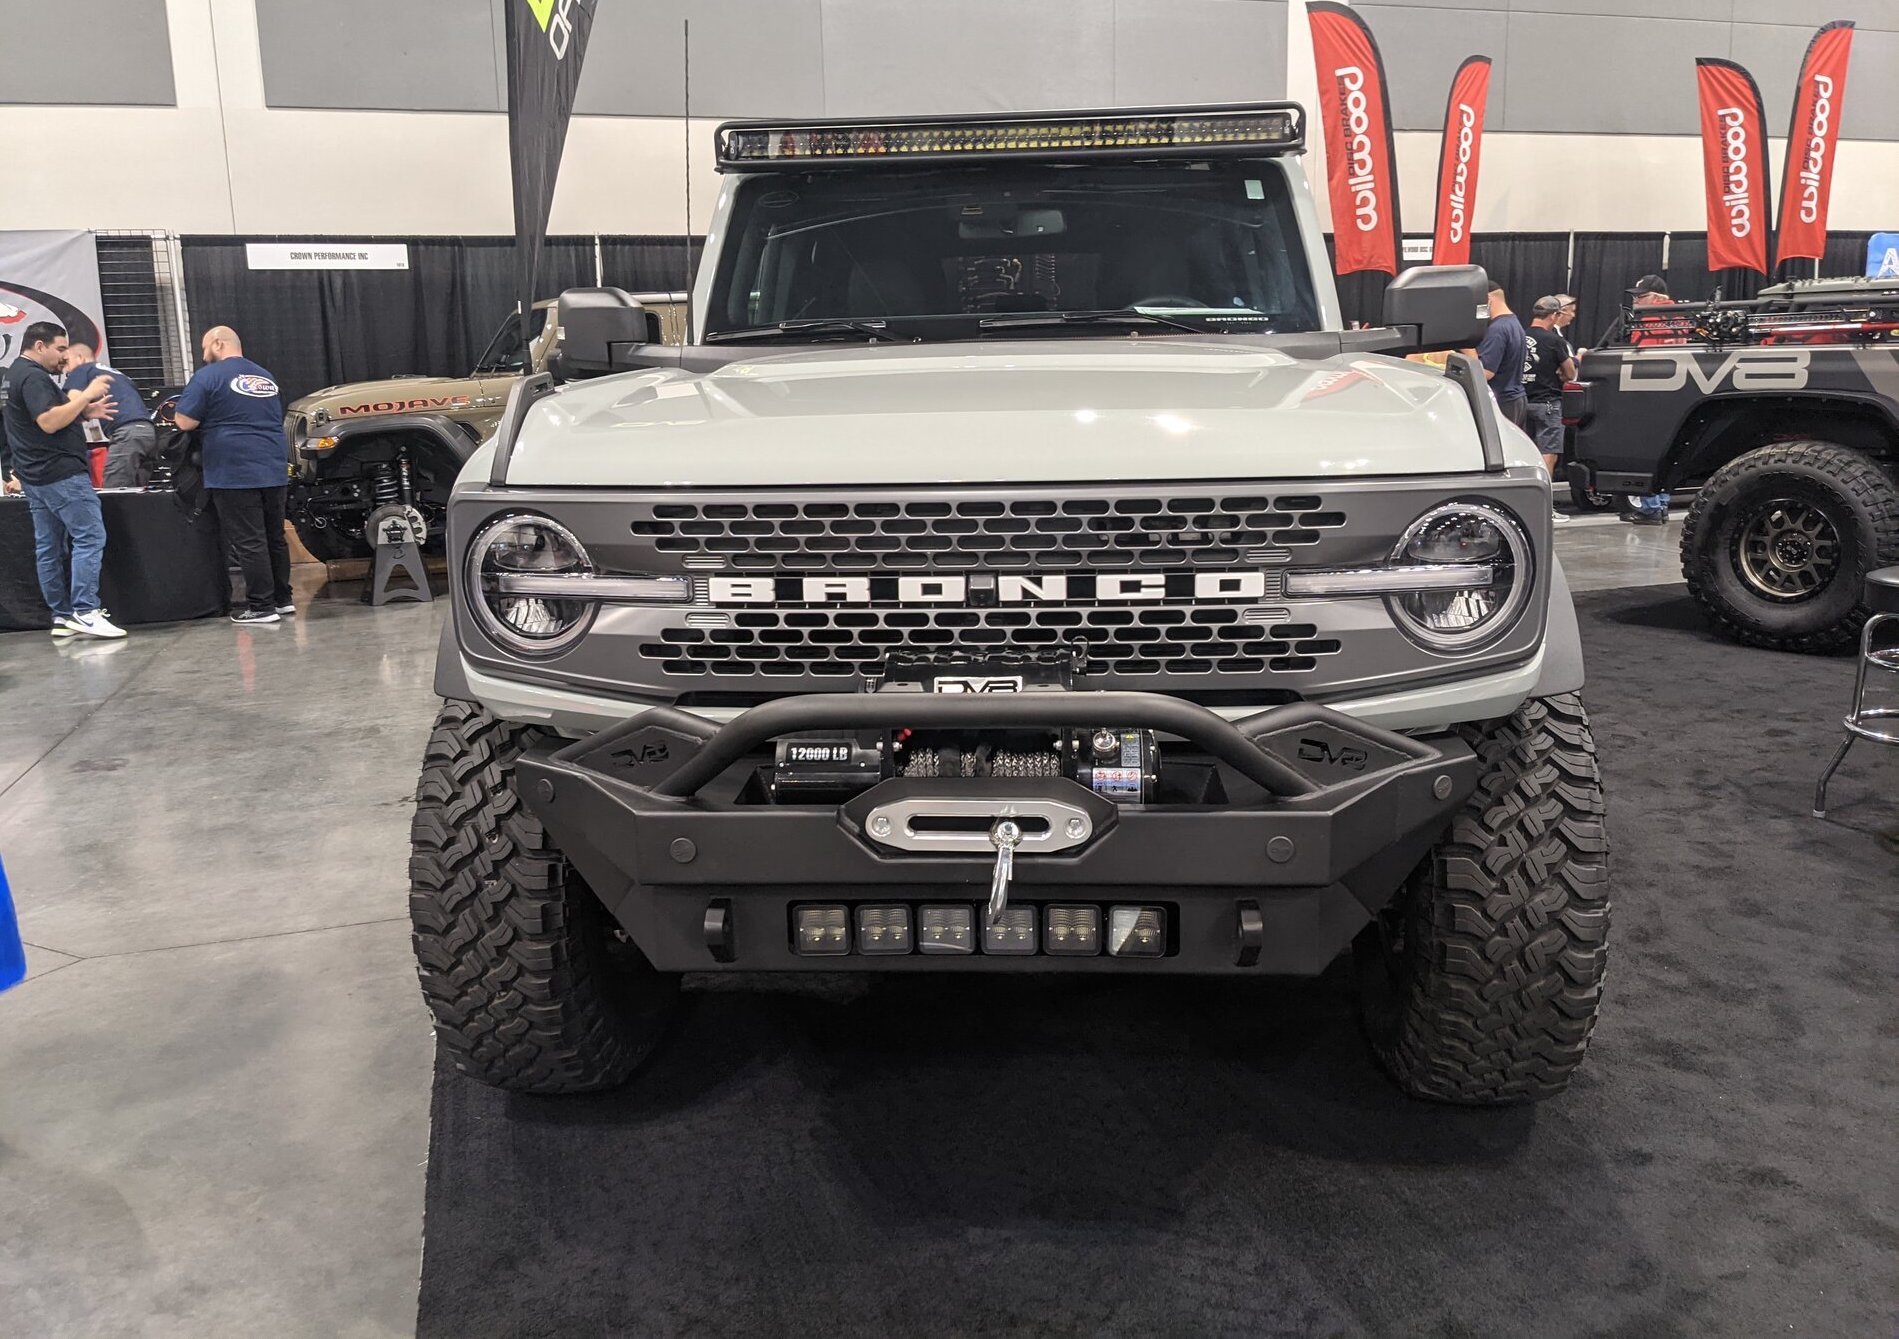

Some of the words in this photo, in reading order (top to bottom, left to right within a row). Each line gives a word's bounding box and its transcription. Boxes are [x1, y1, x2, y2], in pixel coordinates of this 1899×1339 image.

[1335, 65, 1378, 231] wilwood
[1799, 73, 1834, 223] wilwood
[1450, 103, 1475, 243] wilwood
[1717, 107, 1751, 238] wilwood
[289, 251, 313, 260] CROWN
[313, 251, 357, 260] PERFORMANCE
[358, 251, 369, 260] INC
[1619, 350, 1811, 395] DV8
[339, 395, 471, 415] MOJAVE
[708, 572, 1265, 601] BRONCO
[832, 746, 849, 761] LB
[1297, 738, 1368, 770] DV8
